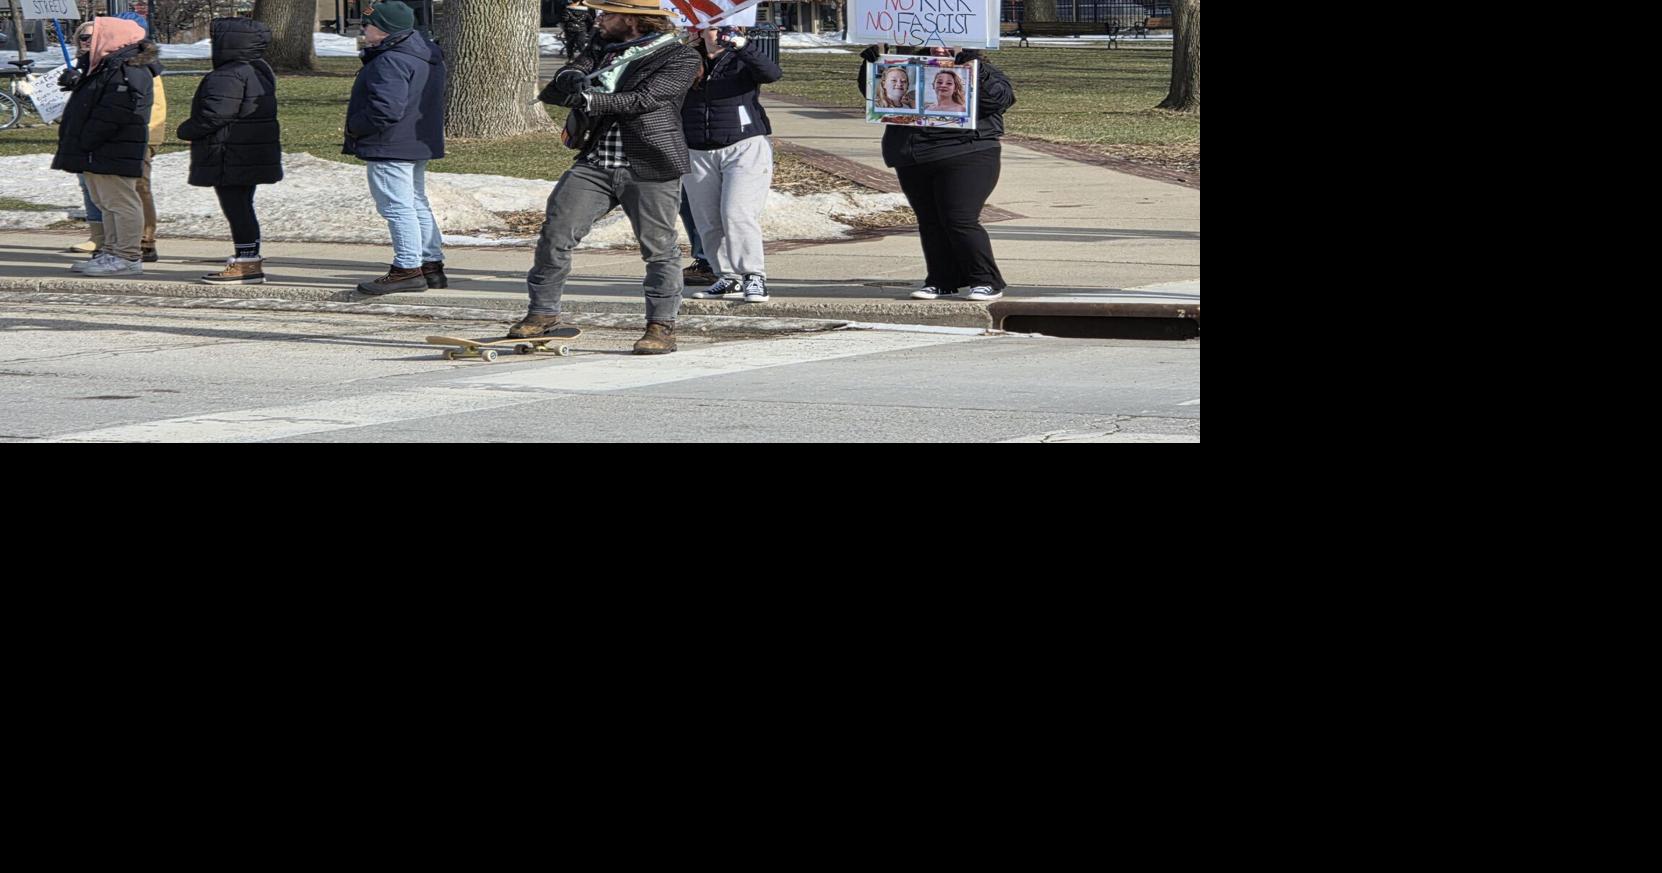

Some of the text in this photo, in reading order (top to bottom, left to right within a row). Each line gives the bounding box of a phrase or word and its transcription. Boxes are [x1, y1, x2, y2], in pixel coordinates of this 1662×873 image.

[866, 11, 976, 34] NO FASCIST
[893, 30, 945, 47] USA
